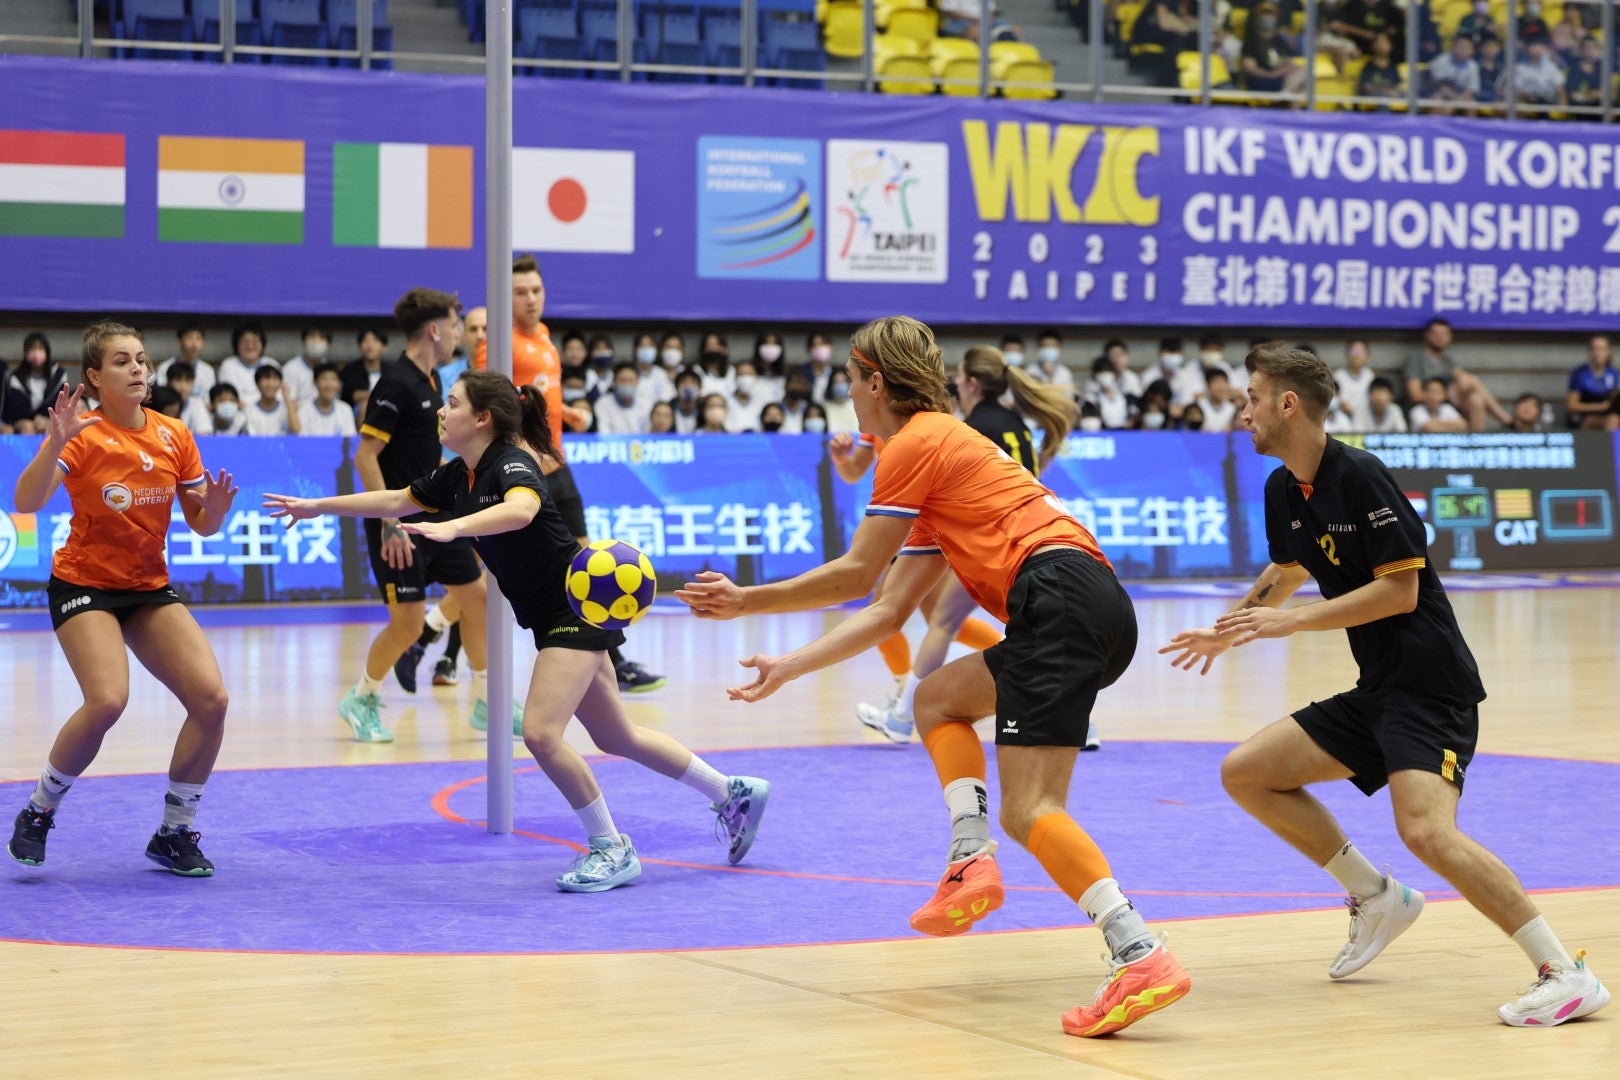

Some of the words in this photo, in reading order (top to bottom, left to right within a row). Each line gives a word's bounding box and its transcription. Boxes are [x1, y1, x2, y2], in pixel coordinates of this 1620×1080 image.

[1183, 126, 1266, 176] IKF
[1282, 130, 1468, 185] WORLD
[1485, 139, 1620, 190] KORF
[1182, 192, 1580, 251] CHAMPIONSHIP
[873, 232, 937, 253] TAIPEI
[973, 232, 1157, 265] 2023
[973, 269, 1156, 301] TAIPEI
[139, 450, 154, 472] 9
[1494, 520, 1540, 546] CAT
